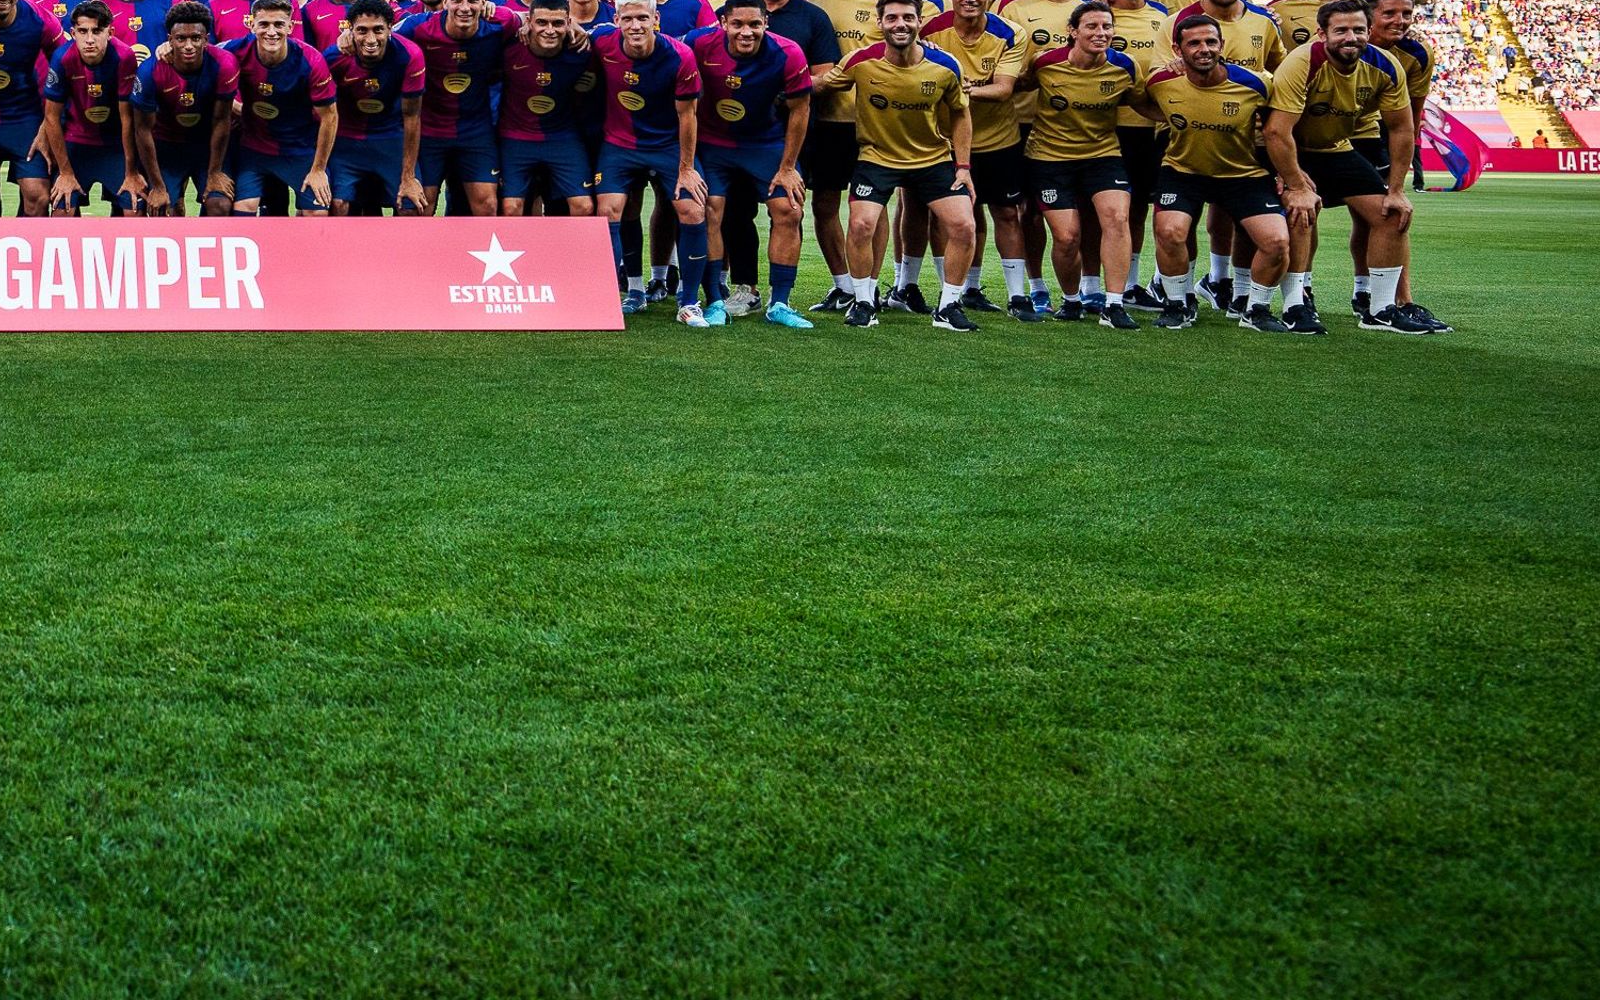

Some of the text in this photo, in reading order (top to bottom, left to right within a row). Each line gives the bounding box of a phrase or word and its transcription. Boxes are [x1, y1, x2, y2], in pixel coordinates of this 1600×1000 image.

[835, 29, 865, 41] potify
[1130, 39, 1155, 50] Spot
[1191, 120, 1236, 132] Spotify
[1558, 151, 1576, 171] LA
[448, 285, 555, 303] ESTRELLA
[485, 303, 522, 313] DAMM
